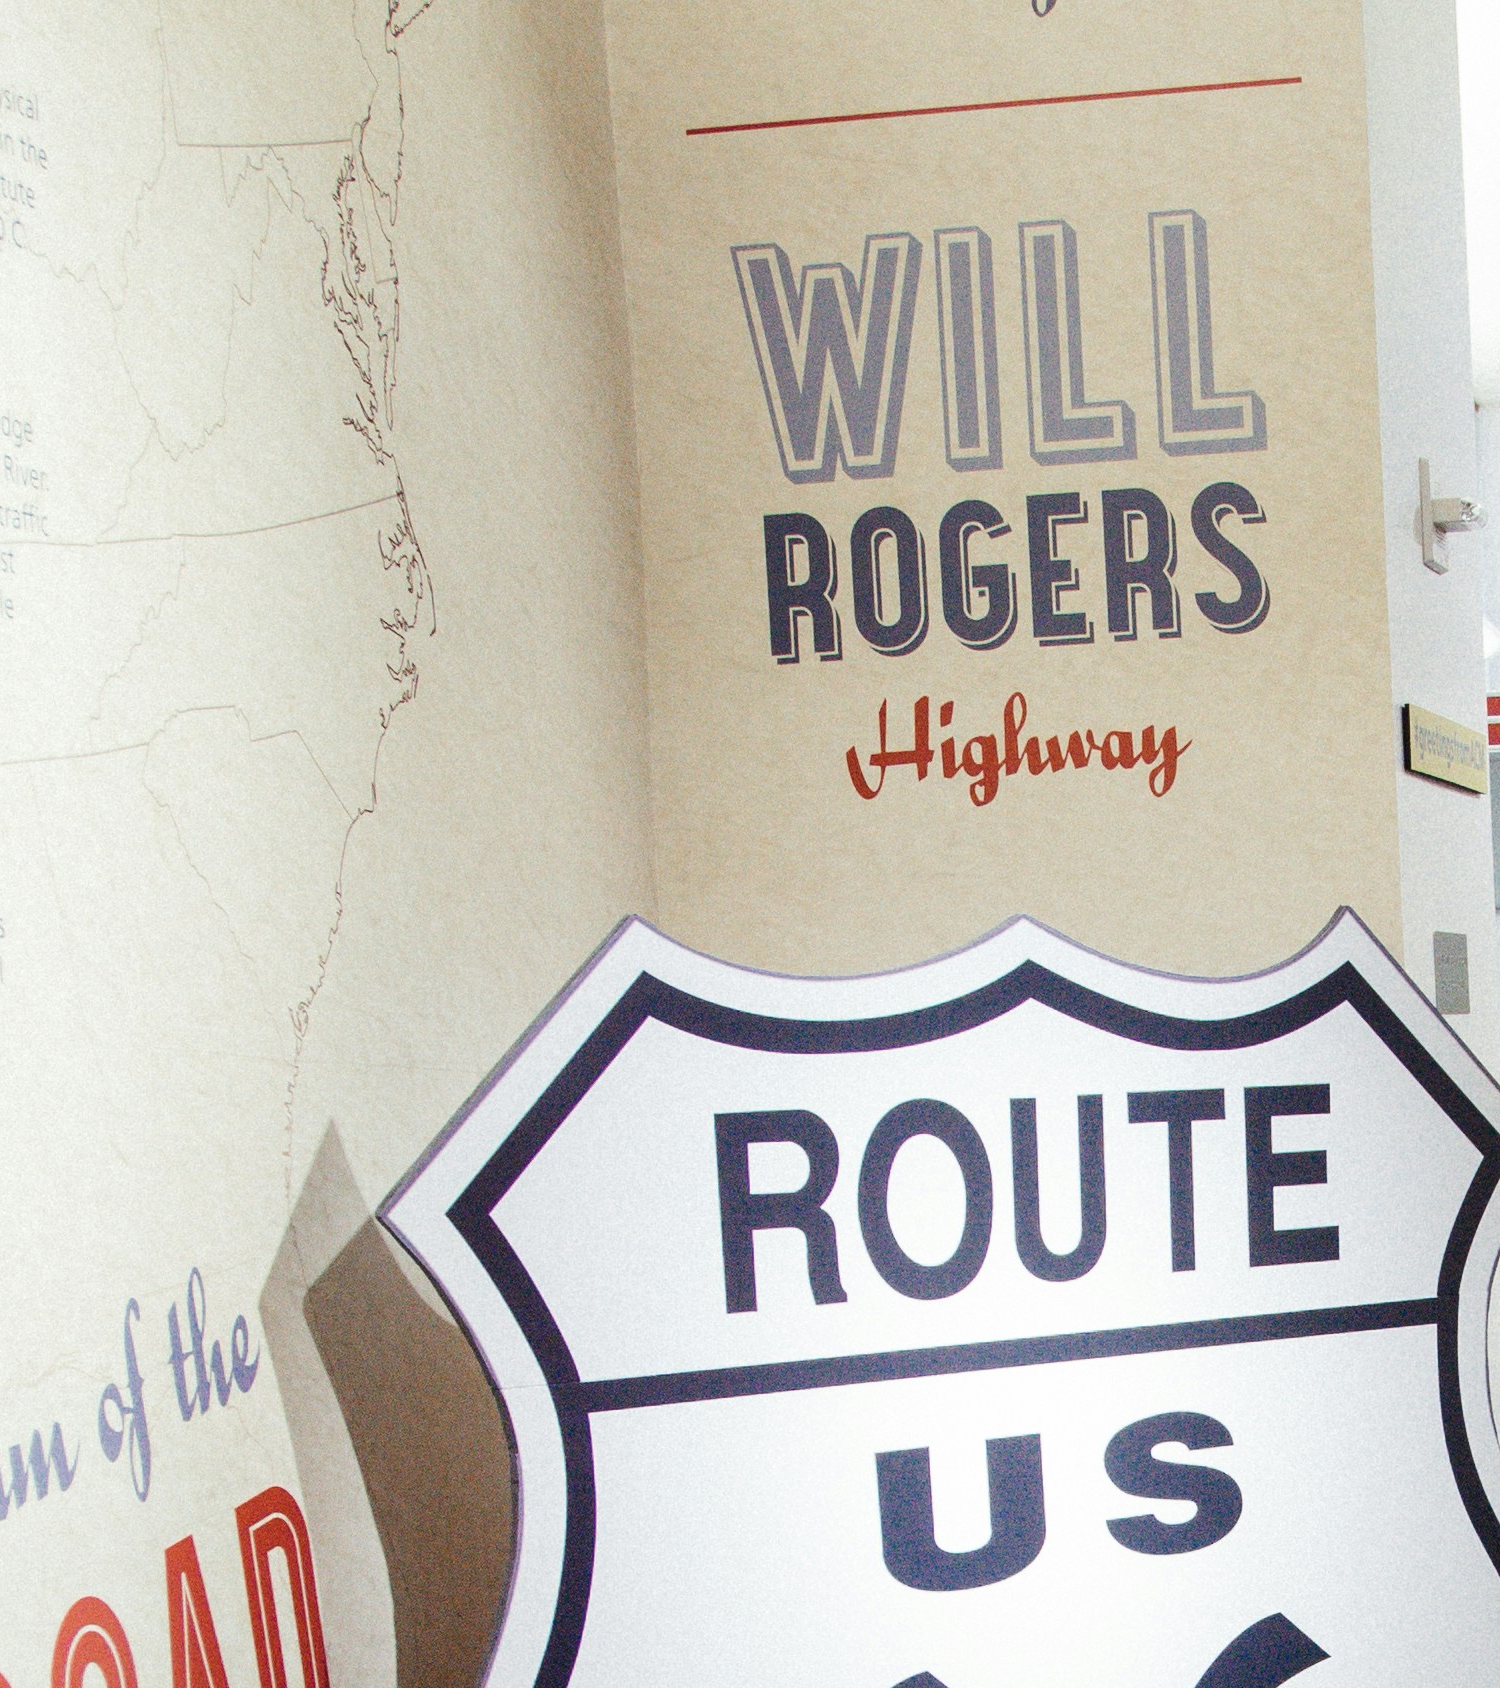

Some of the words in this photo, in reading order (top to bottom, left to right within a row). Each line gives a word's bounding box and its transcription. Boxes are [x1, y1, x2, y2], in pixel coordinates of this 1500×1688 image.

[18, 136, 49, 170] the
[731, 209, 1267, 485] WILL
[763, 482, 1270, 665] ROGERS
[845, 691, 1192, 807] Highway
[714, 1083, 1341, 1314] ROUTE
[97, 1297, 156, 1500] of
[163, 1266, 264, 1442] the
[875, 1411, 1244, 1592] US
